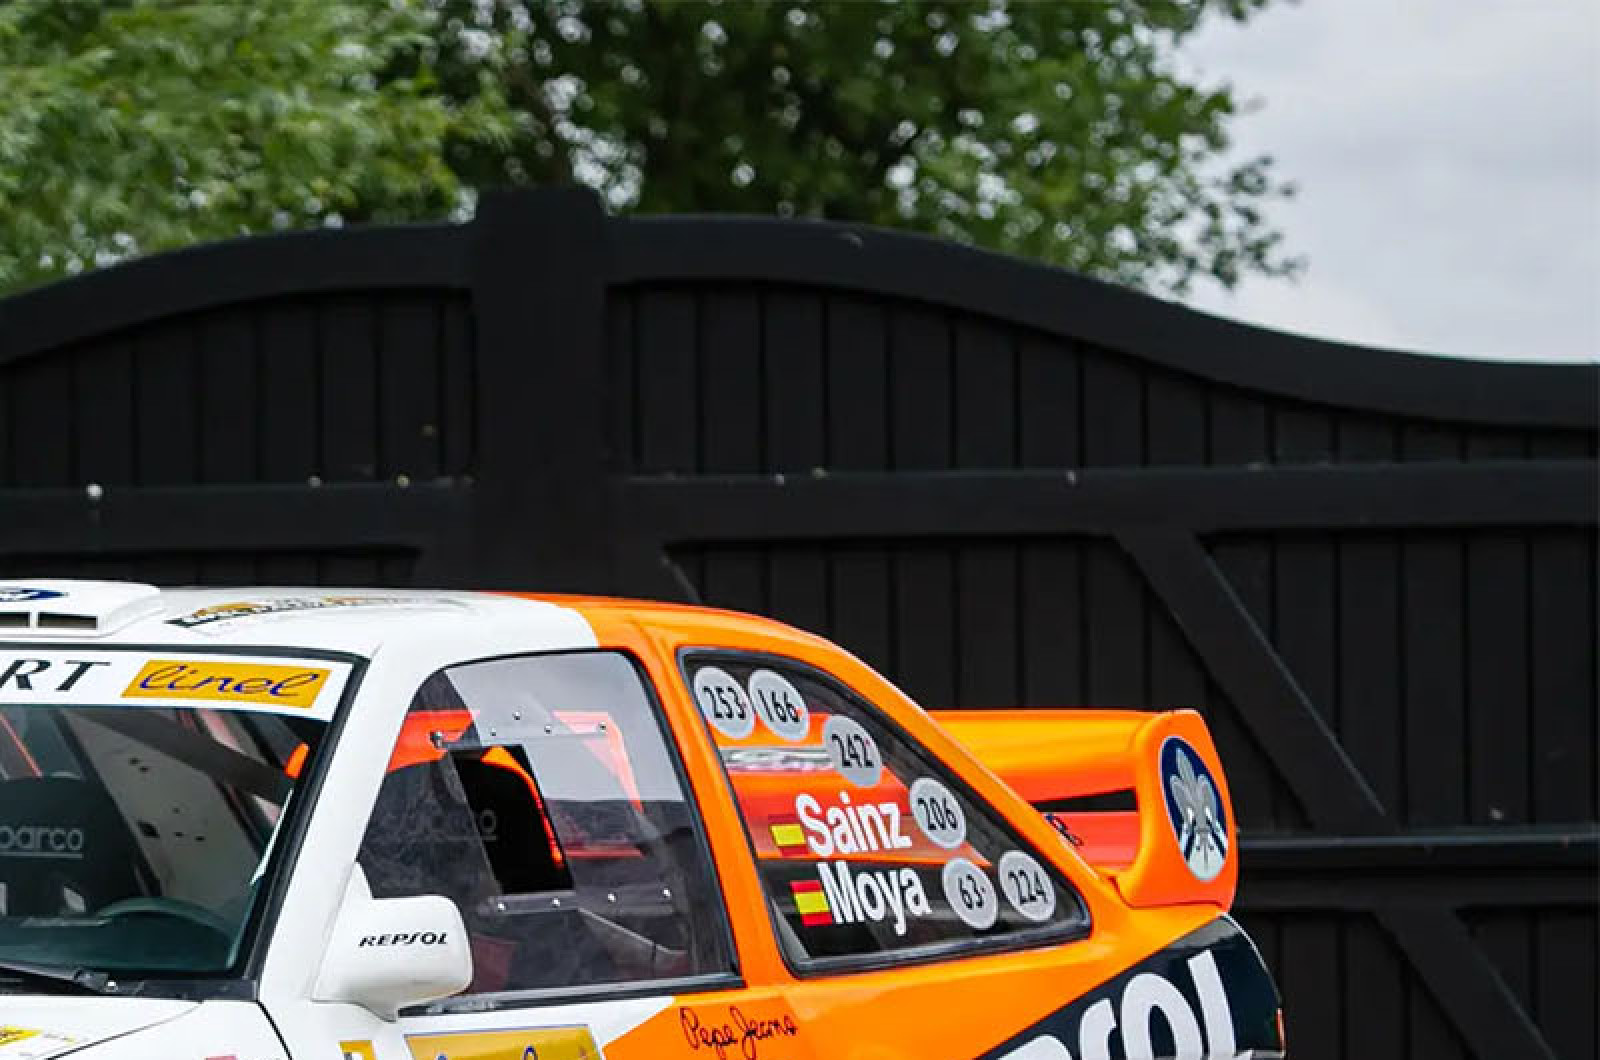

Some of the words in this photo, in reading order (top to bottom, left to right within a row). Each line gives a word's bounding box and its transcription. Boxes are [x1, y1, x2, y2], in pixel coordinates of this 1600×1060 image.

[140, 664, 320, 697] linel
[703, 685, 747, 721] 253
[758, 689, 800, 723] 166
[831, 733, 875, 769] 242
[795, 791, 913, 857] Sainz
[917, 796, 960, 831] 206
[817, 860, 933, 937] Moya
[1008, 868, 1050, 905] 224
[359, 931, 448, 947] REPSOL
